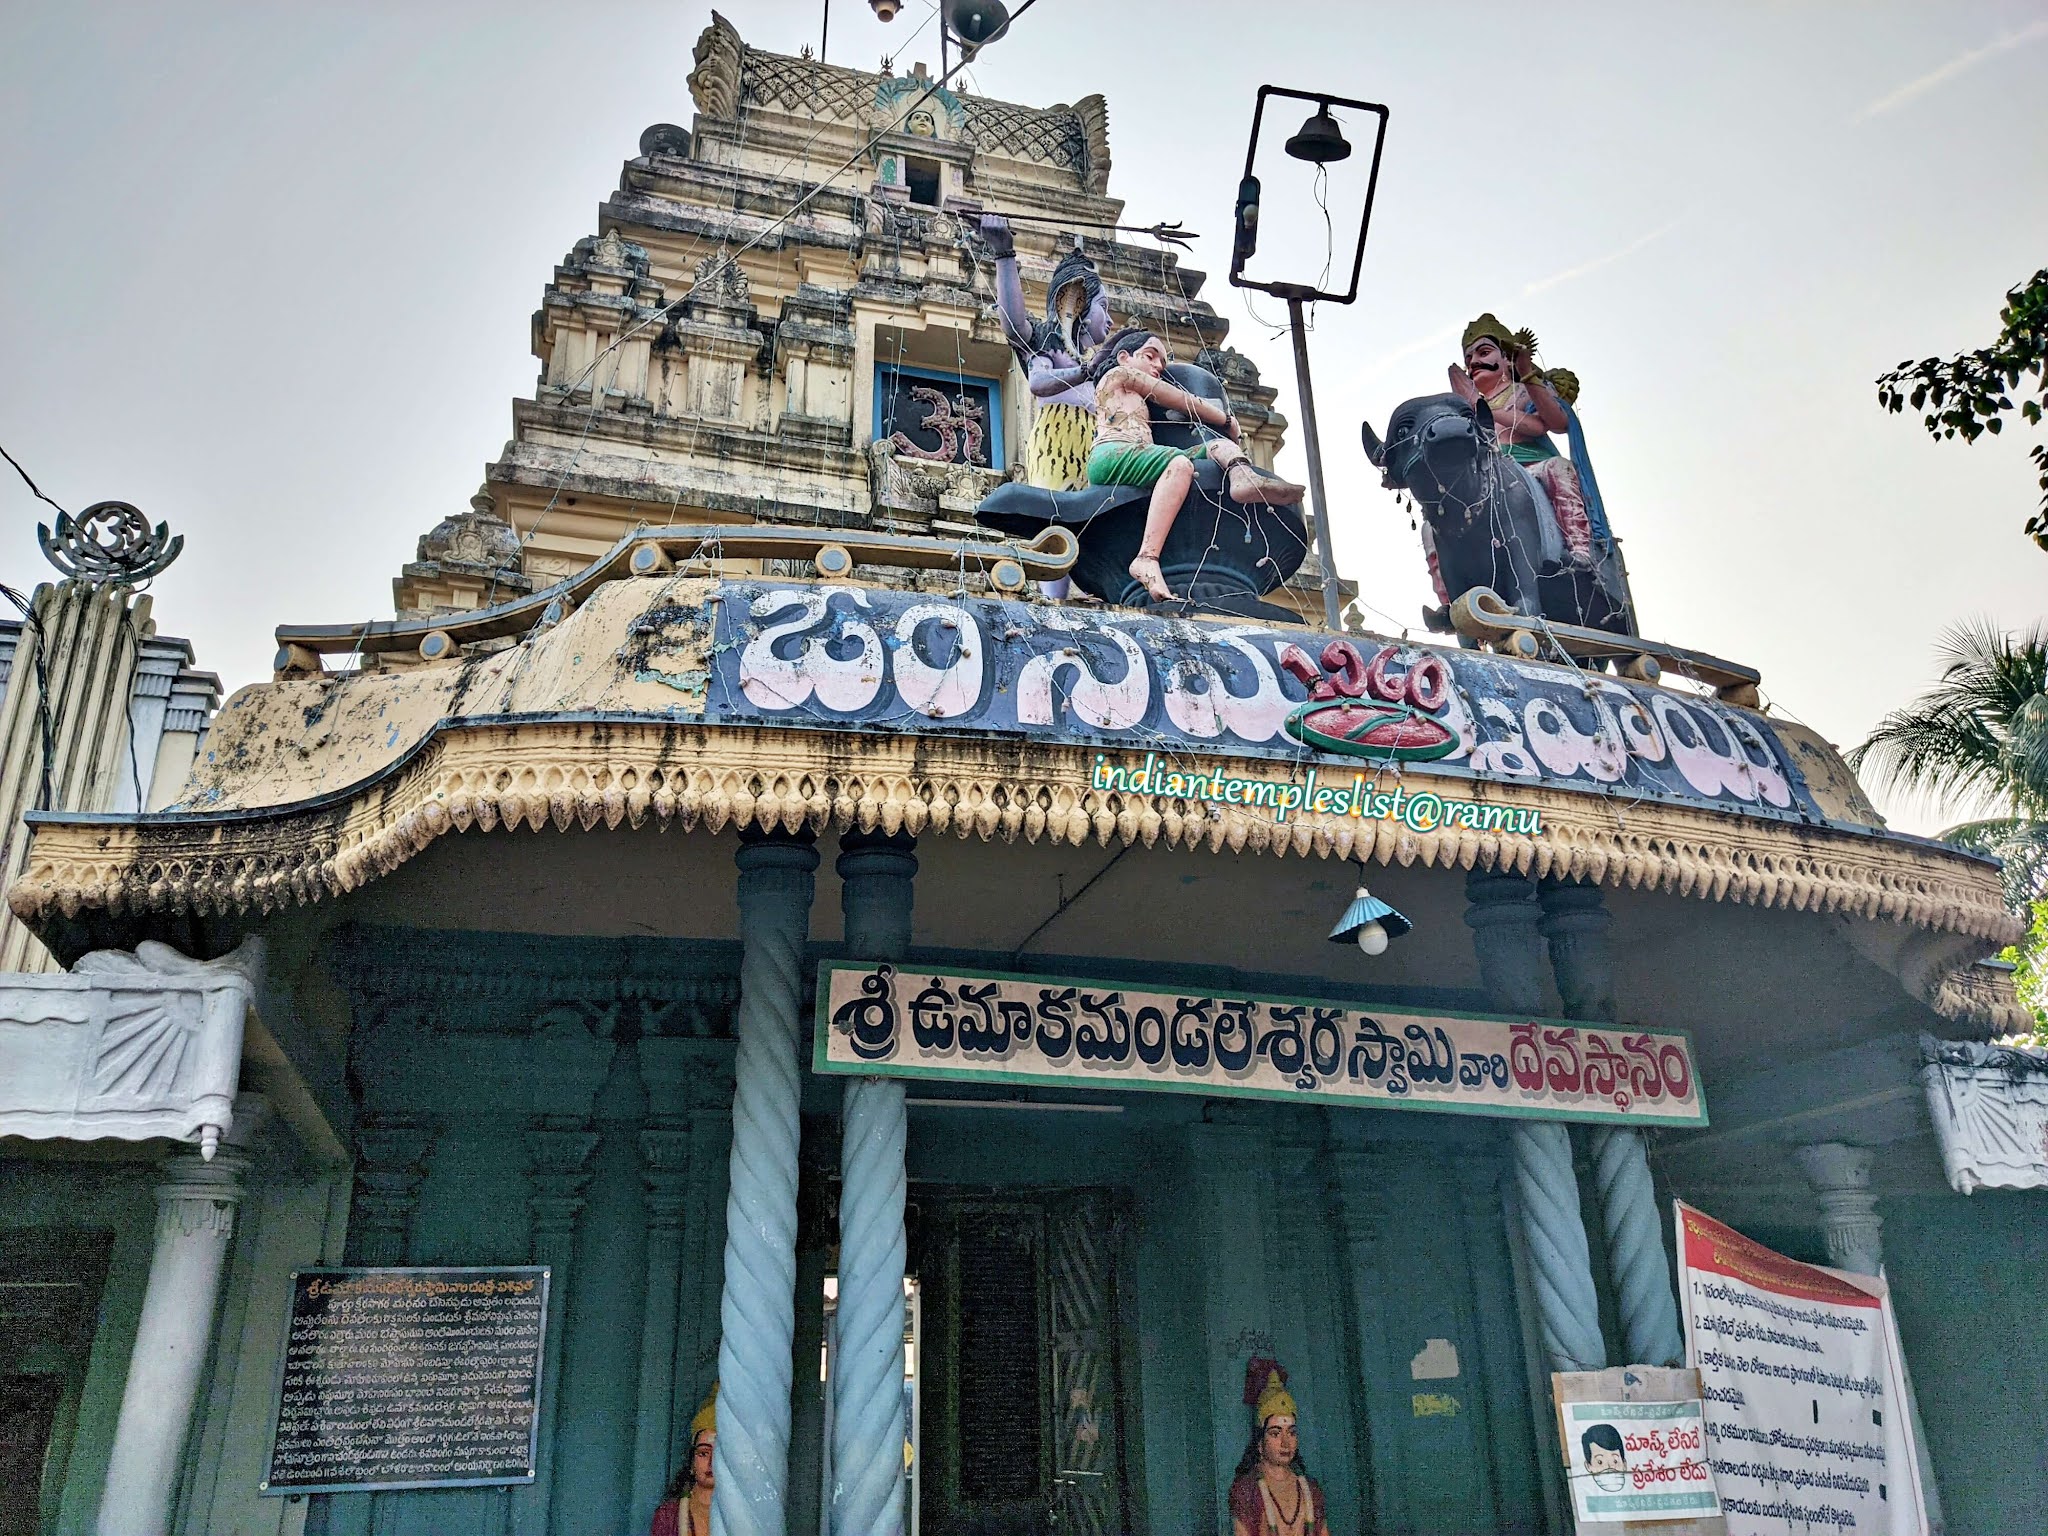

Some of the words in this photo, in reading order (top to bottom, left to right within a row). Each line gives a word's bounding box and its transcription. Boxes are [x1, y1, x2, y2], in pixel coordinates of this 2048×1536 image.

[740, 585, 984, 718] ఓం
[1509, 1021, 1690, 1112] దేవస్థానం
[1624, 1430, 1668, 1458] మాస్క్
[1668, 1426, 1700, 1449] లేనిదే
[1632, 1459, 1676, 1490] ప్రవేశం
[1679, 1457, 1707, 1481] లేదు
